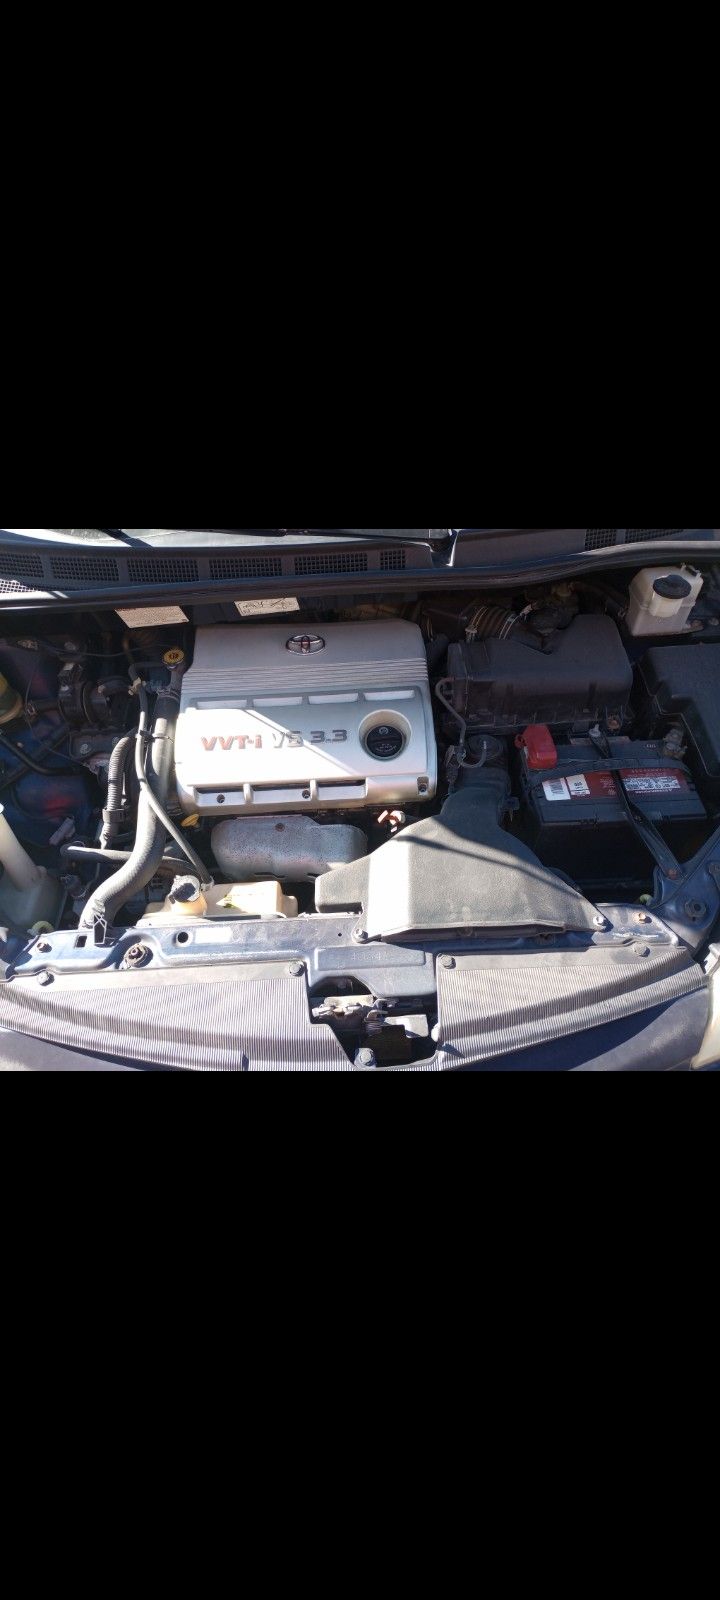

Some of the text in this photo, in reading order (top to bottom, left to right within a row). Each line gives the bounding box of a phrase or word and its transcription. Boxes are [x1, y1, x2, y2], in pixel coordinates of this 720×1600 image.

[201, 728, 348, 751] VVT-i V6 3.3
